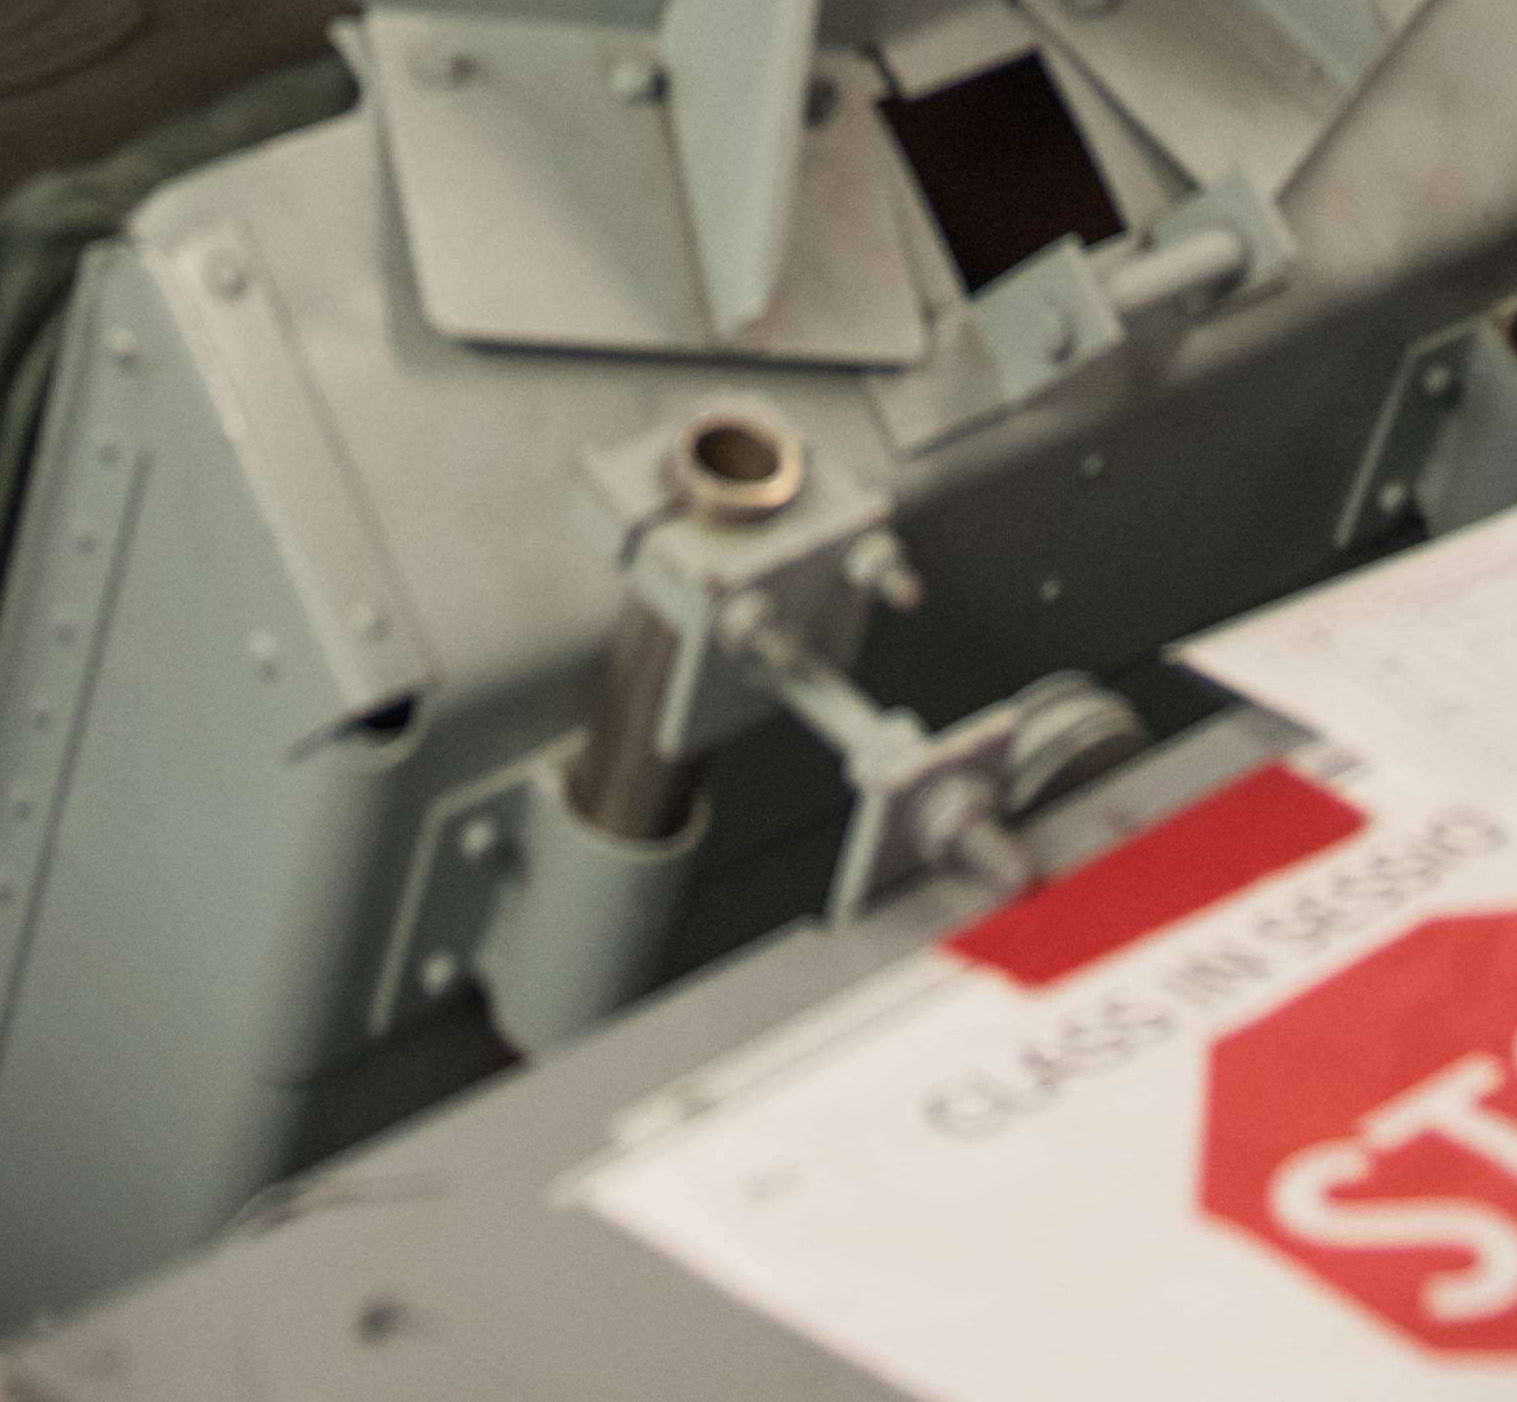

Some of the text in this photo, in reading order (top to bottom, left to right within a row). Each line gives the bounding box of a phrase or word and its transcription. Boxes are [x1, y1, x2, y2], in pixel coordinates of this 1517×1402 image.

[920, 803, 1510, 1143] CLASS IN SESSIO
